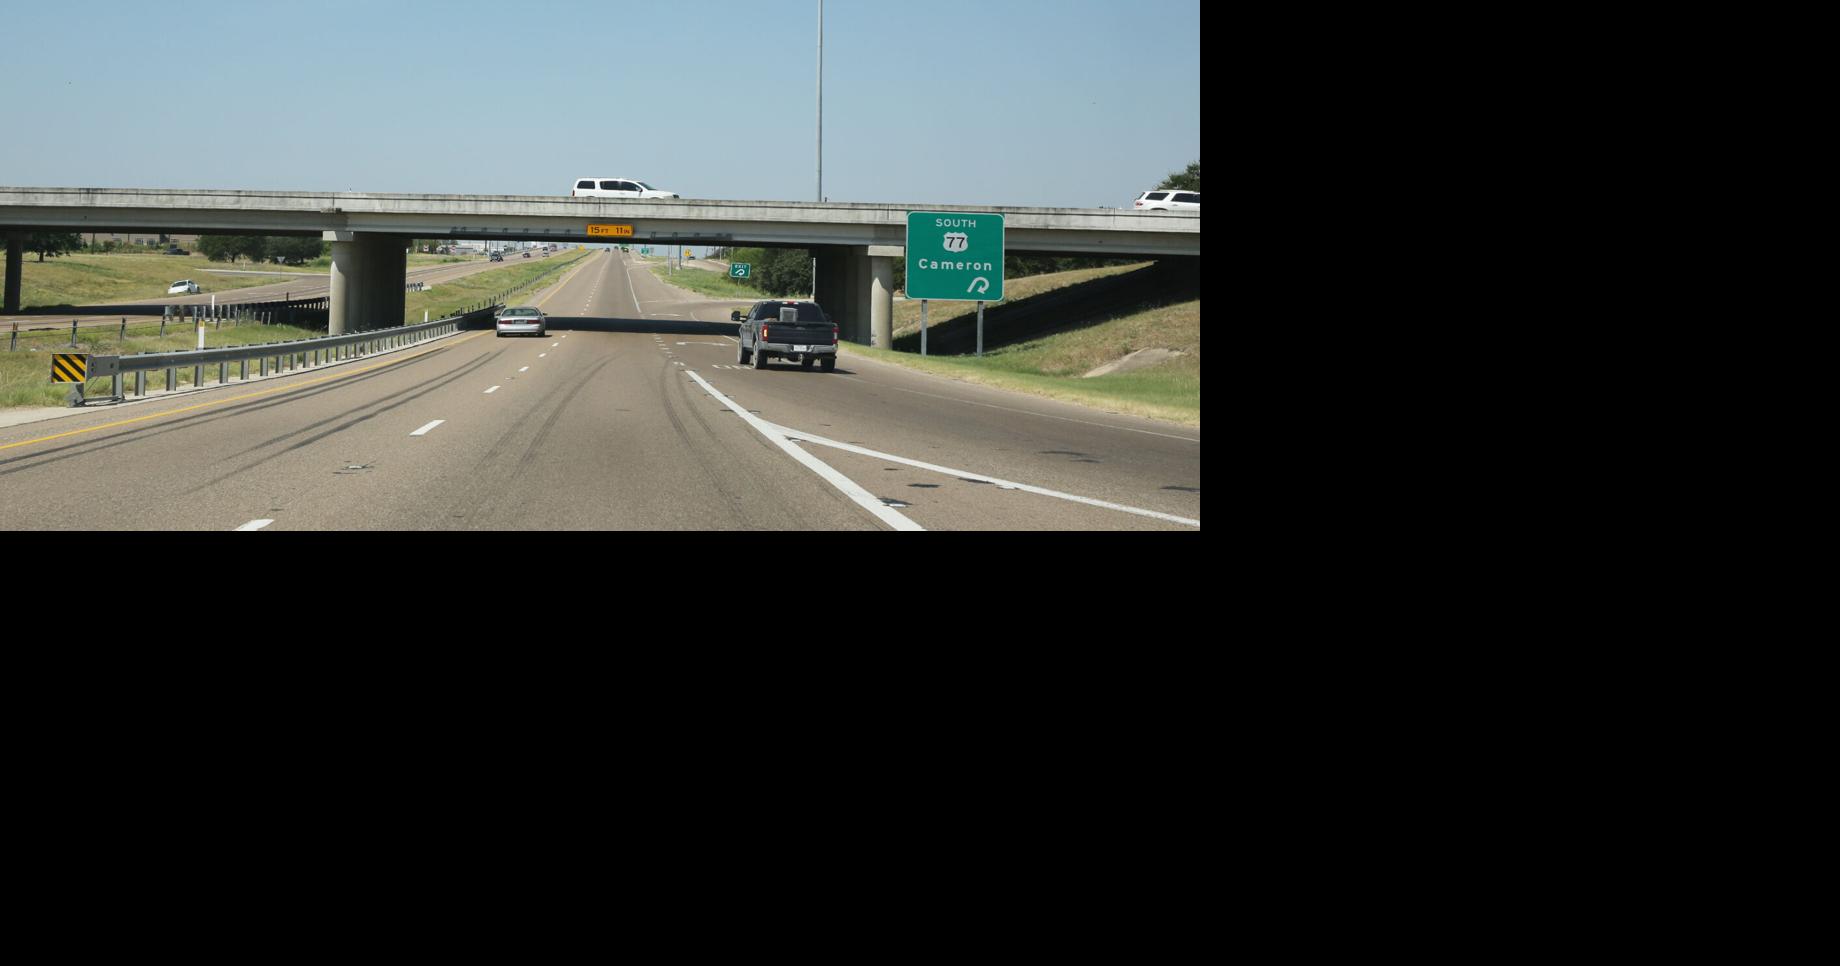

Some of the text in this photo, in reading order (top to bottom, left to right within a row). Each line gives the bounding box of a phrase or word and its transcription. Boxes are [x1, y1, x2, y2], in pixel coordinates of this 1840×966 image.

[935, 218, 977, 228] SOUTH
[590, 226, 600, 234] 15
[946, 236, 966, 248] 77
[918, 258, 992, 271] Cameron
